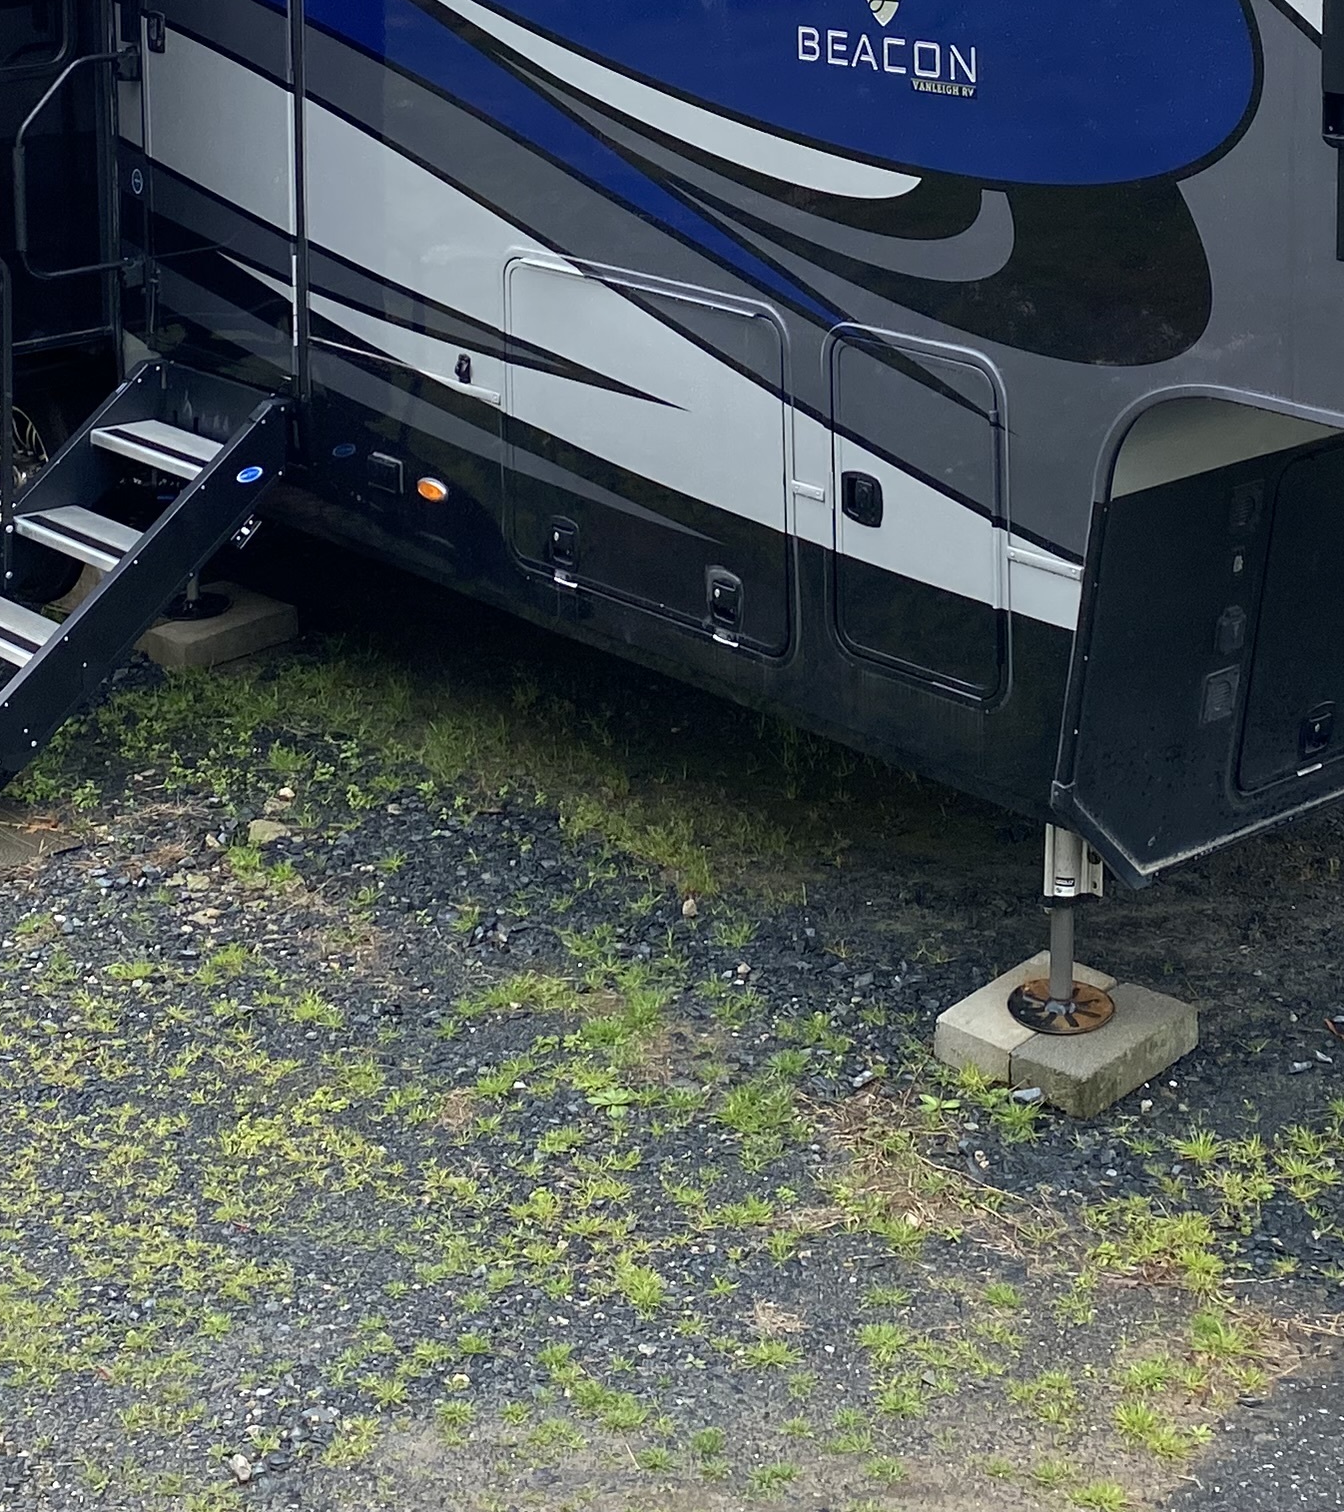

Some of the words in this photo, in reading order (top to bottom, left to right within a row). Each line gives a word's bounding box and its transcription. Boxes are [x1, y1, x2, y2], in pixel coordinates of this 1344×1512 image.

[797, 25, 977, 83] BEACON
[912, 80, 959, 97] VANLEIGH
[961, 88, 975, 98] RV
